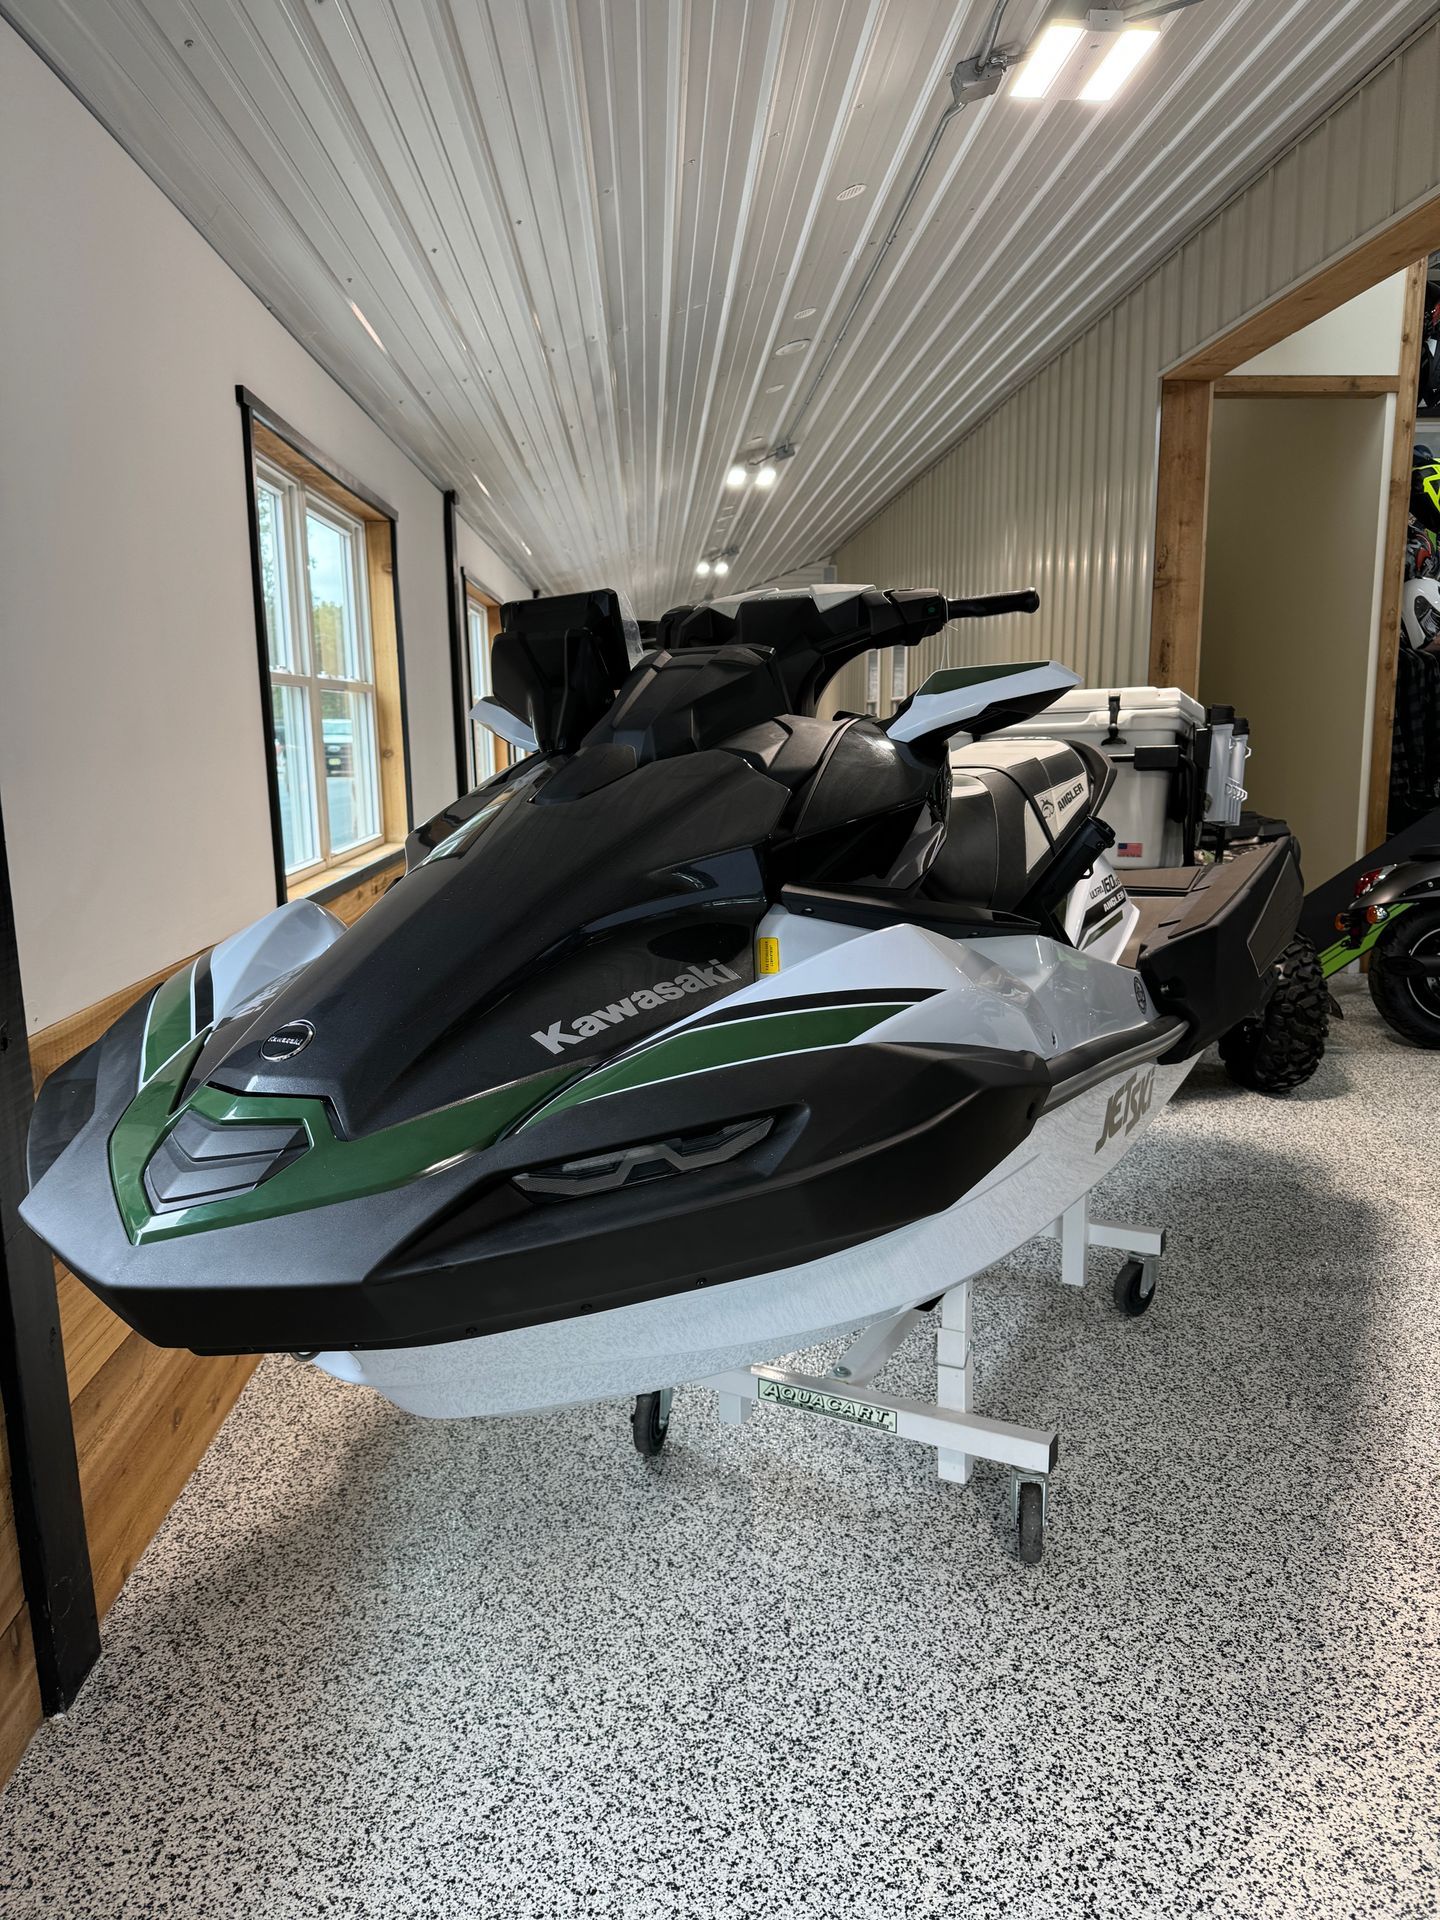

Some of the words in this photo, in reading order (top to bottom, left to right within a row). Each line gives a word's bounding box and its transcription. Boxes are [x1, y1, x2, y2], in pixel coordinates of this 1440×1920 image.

[1057, 783, 1084, 811] ANGLER
[1103, 890, 1125, 912] ANGLER
[530, 958, 742, 1055] Kawasaki
[763, 1382, 890, 1424] AQUACART
